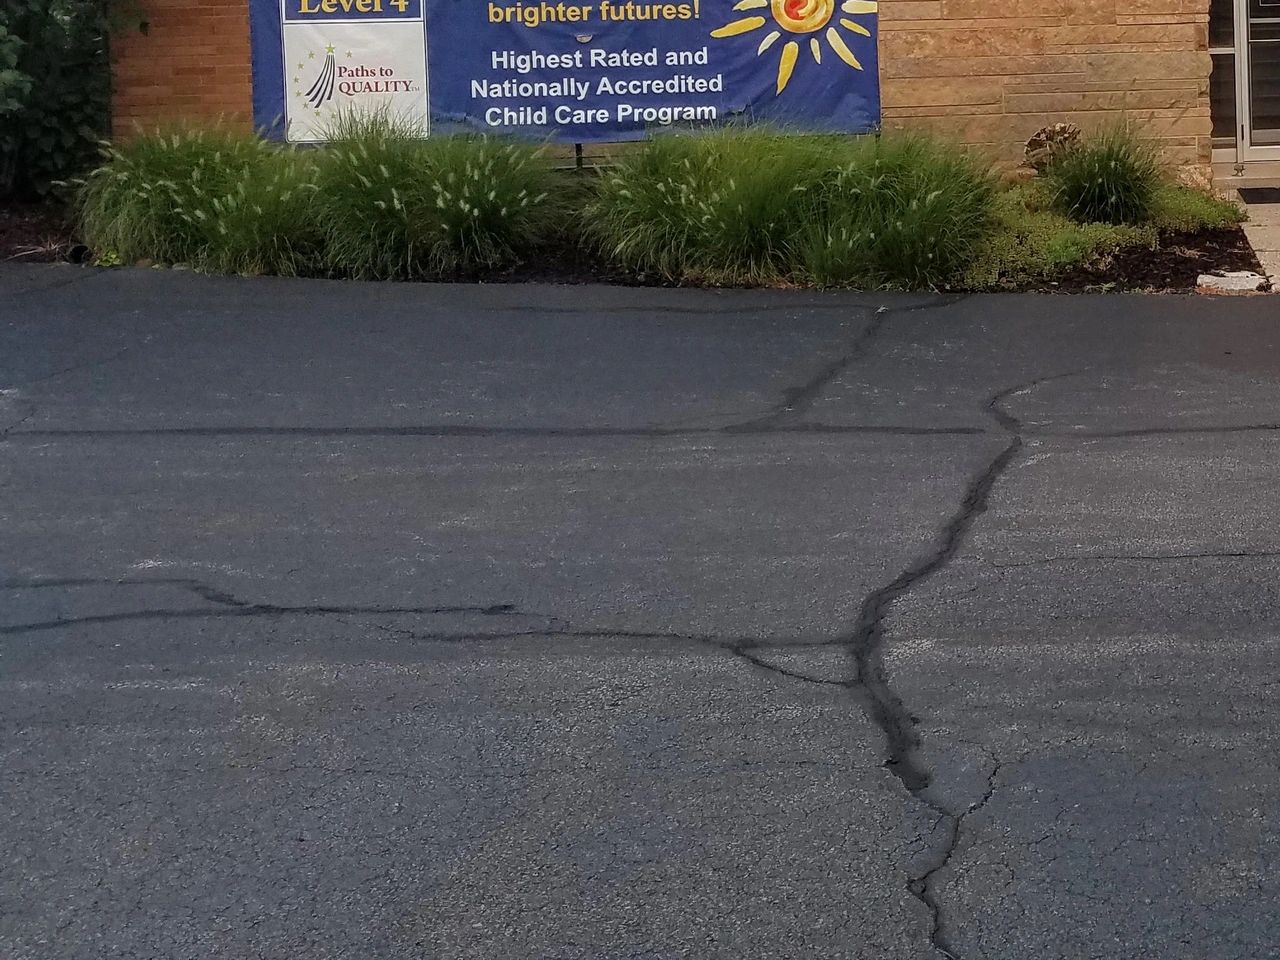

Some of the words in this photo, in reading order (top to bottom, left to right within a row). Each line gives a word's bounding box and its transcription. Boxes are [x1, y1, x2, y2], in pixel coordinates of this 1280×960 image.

[488, 1, 593, 28] brighter
[599, 0, 701, 21] futures!
[337, 64, 376, 78] Paths
[379, 66, 394, 77] to
[491, 49, 583, 74] Highest
[590, 47, 658, 68] Rated
[665, 47, 709, 66] and
[338, 80, 413, 97] QUALITY
[470, 77, 590, 101] Nationally
[596, 74, 723, 95] Accredited
[485, 105, 547, 127] Child
[554, 105, 610, 125] Care
[617, 104, 717, 125] Program
